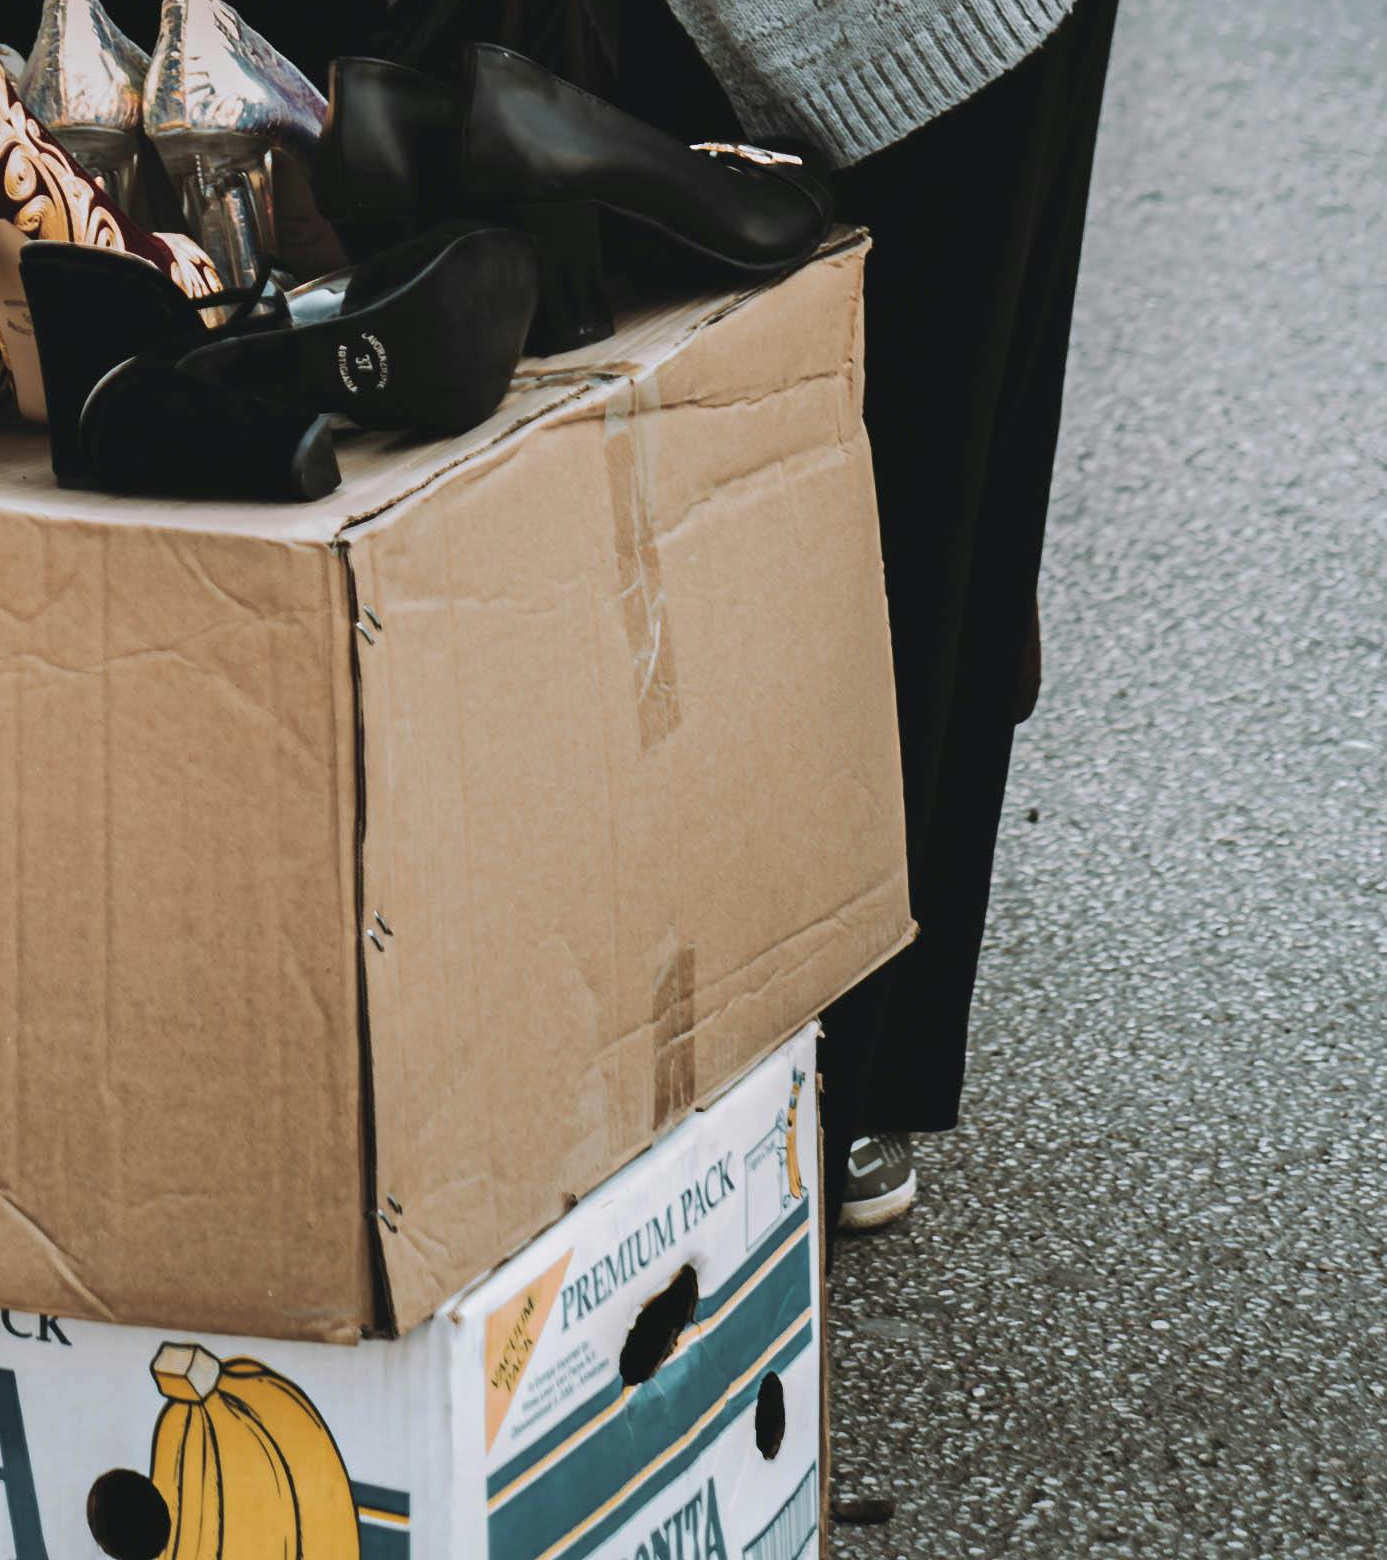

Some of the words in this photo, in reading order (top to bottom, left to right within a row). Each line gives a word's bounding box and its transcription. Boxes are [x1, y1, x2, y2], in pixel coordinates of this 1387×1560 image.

[355, 354, 374, 371] 37
[560, 1204, 677, 1334] PREMIUM
[680, 1150, 737, 1234] PACK
